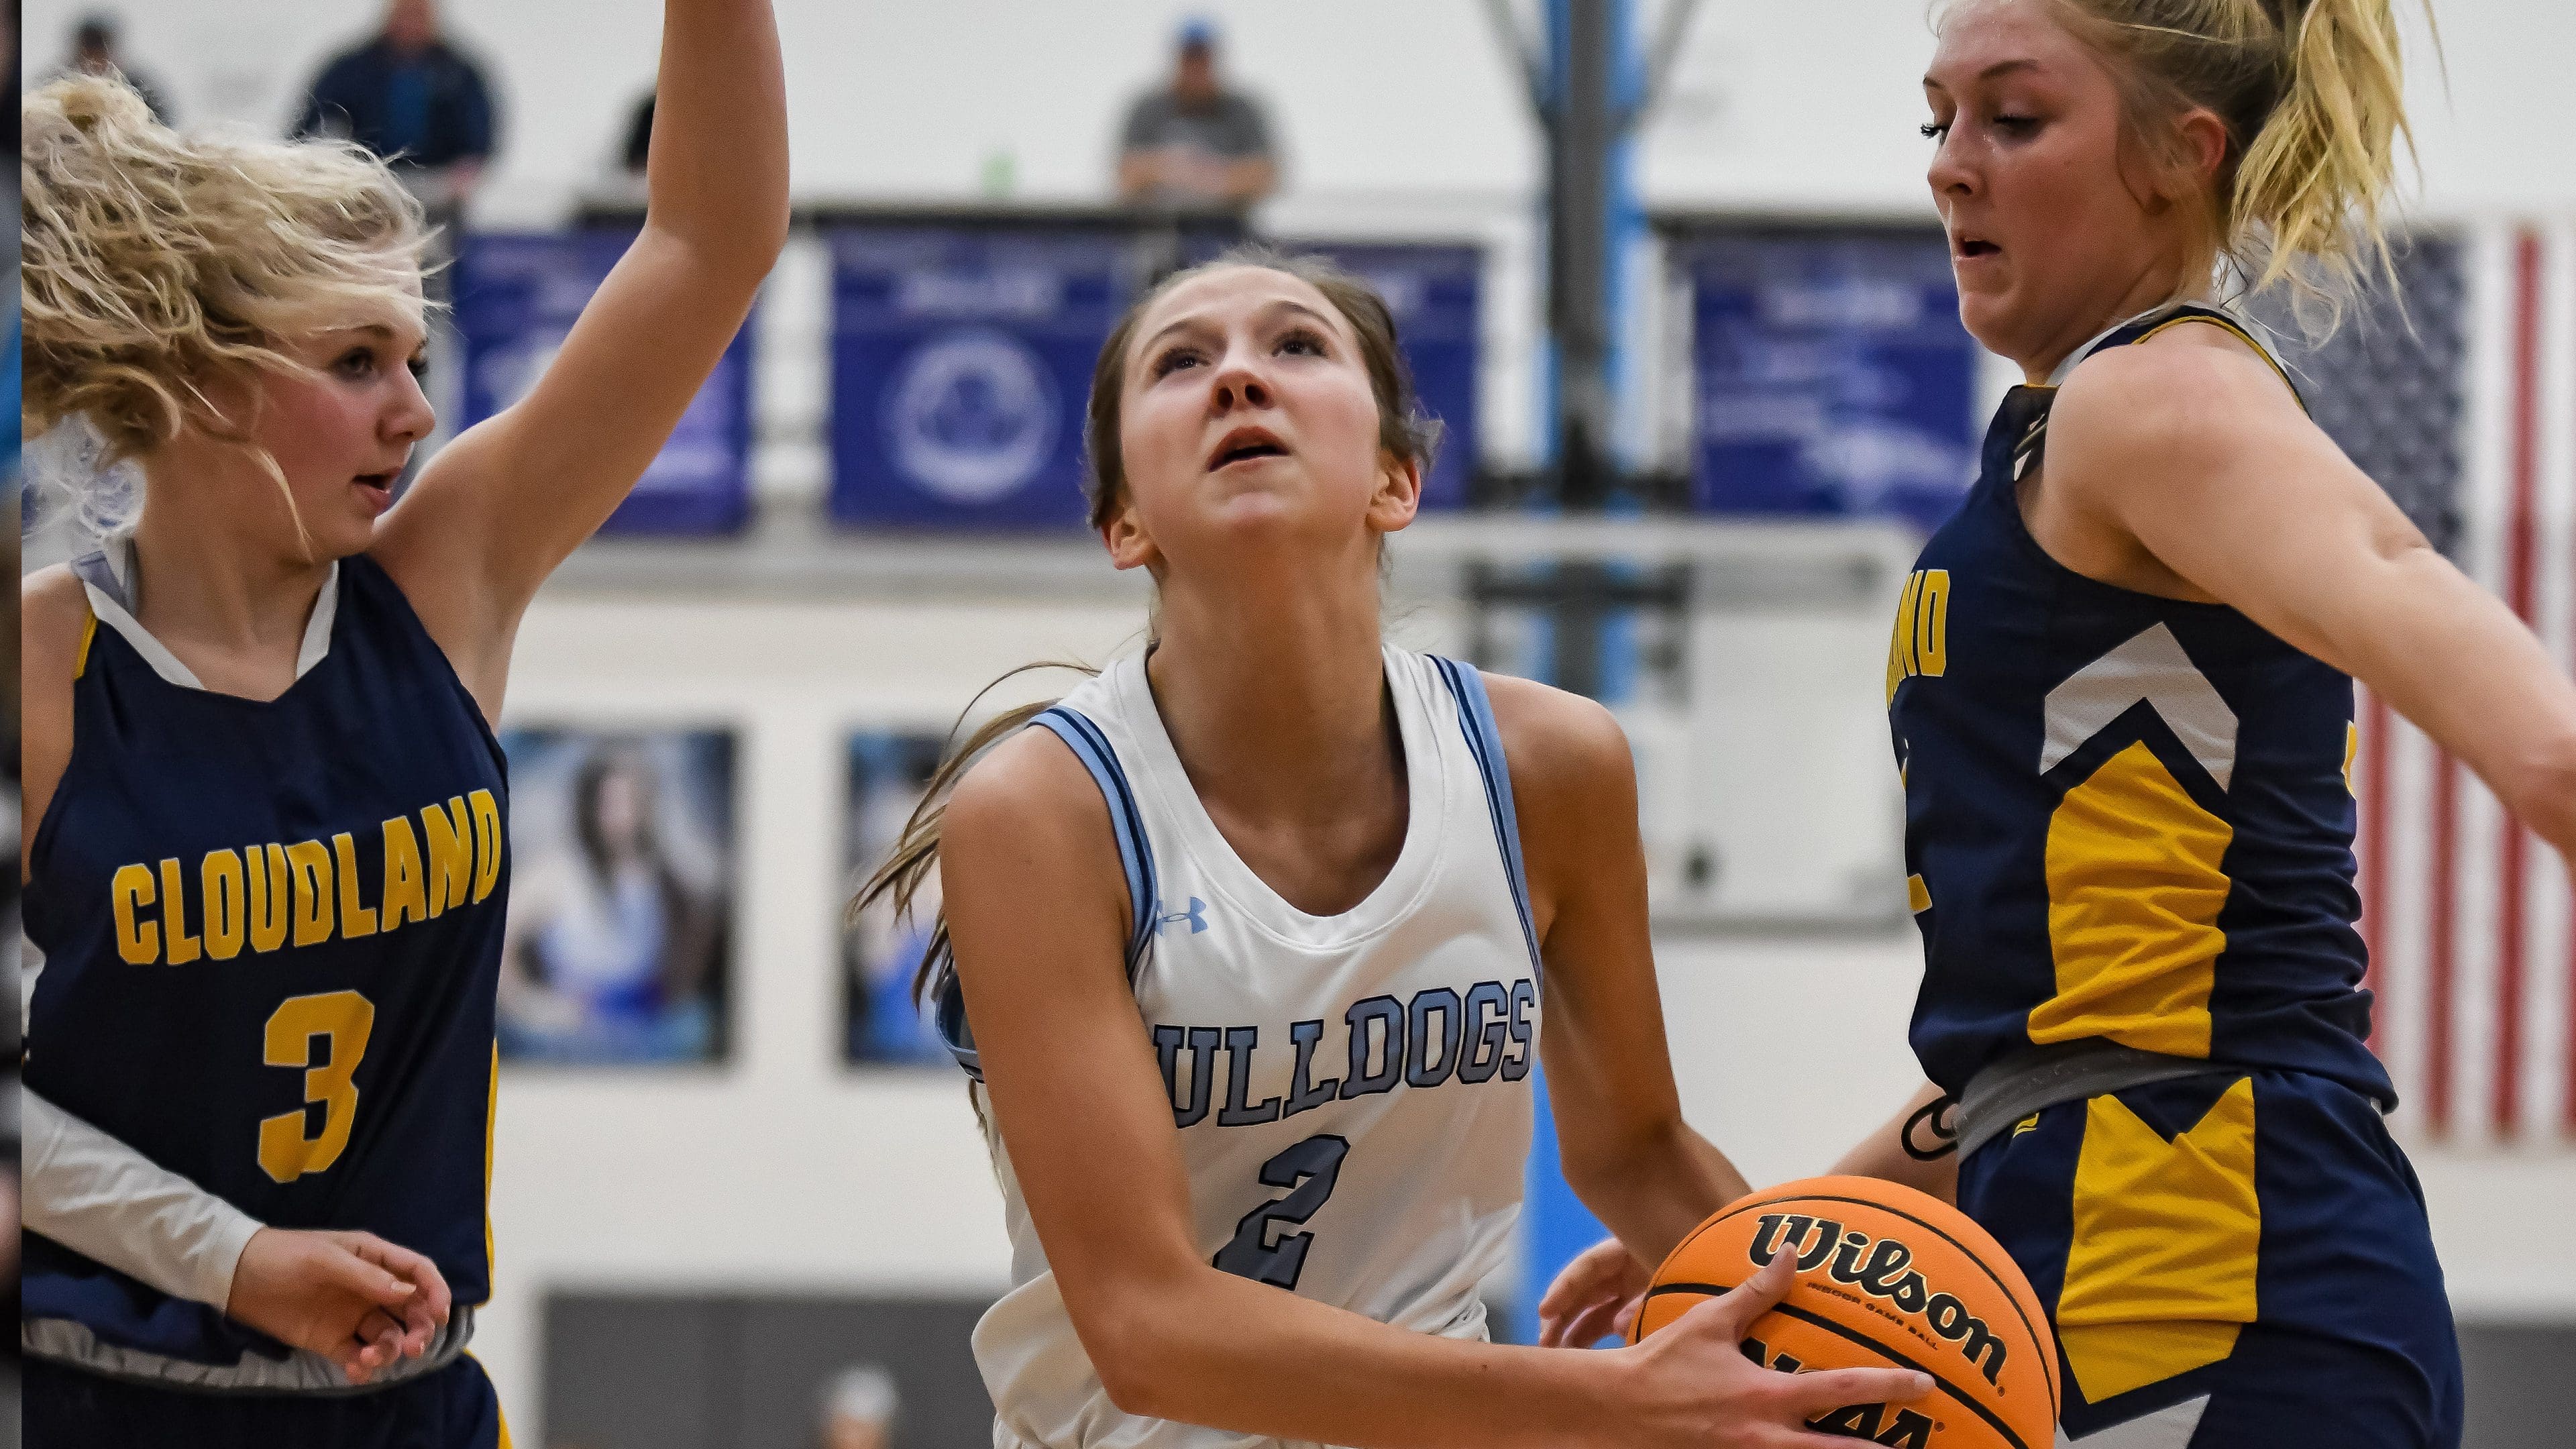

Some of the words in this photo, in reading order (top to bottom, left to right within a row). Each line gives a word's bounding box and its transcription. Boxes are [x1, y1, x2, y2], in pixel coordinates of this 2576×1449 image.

[111, 788, 502, 965] CLOUDLAND
[258, 989, 375, 1183] 3
[1152, 978, 1536, 1129] ULLDOGS
[1212, 1133, 1351, 1291] 2
[1748, 1213, 2008, 1387] Wilson
